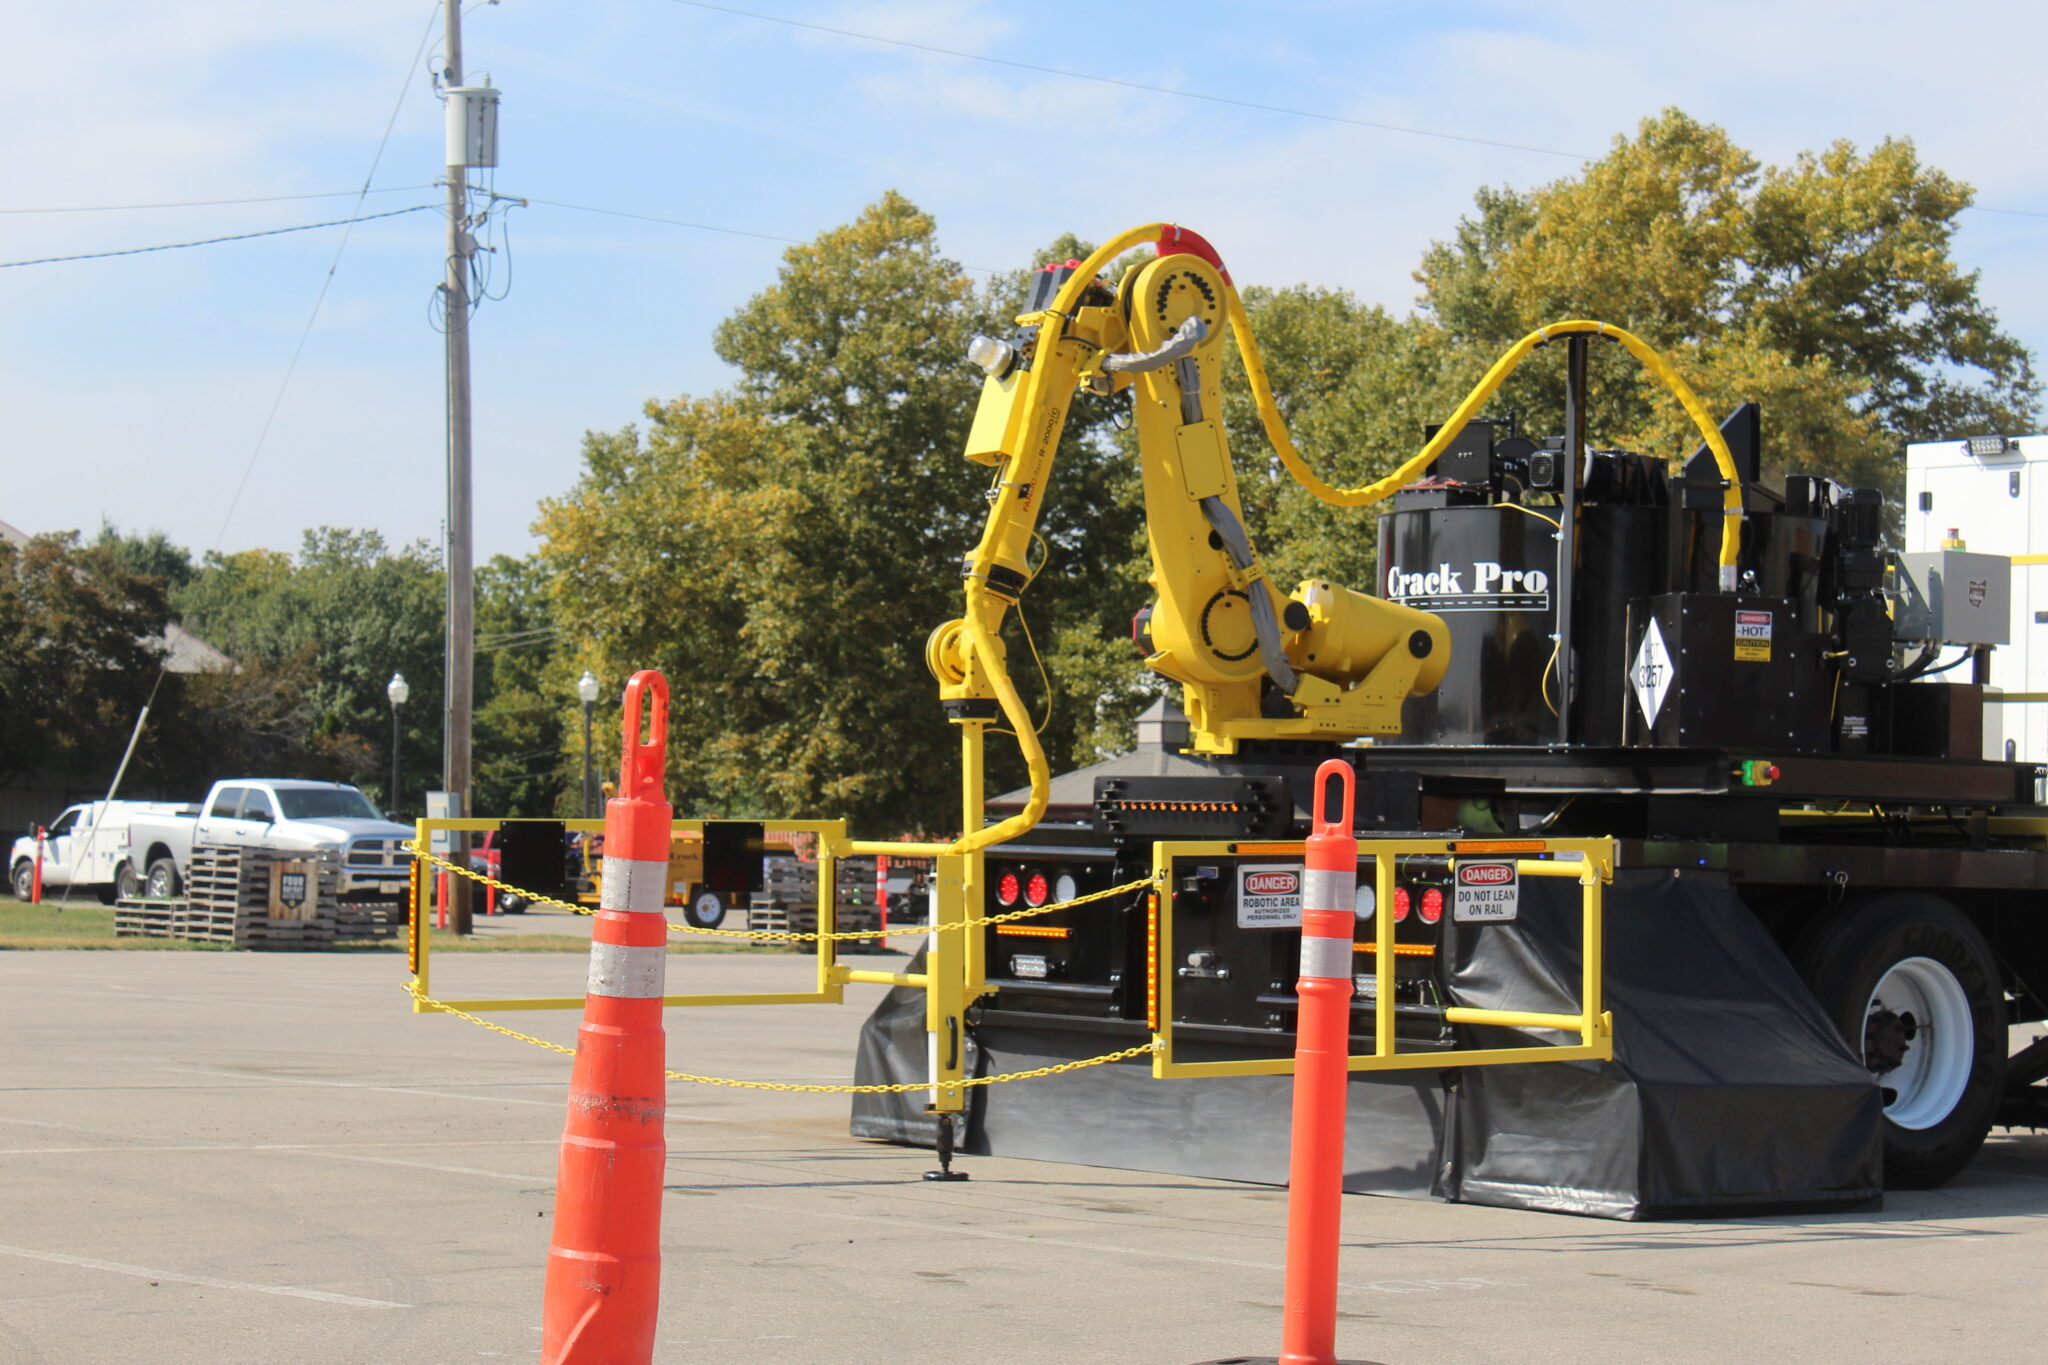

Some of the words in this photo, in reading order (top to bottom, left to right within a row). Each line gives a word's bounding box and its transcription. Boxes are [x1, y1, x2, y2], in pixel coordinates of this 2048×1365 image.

[1387, 562, 1463, 598] Crack
[1473, 562, 1549, 594] Pro
[1741, 614, 1766, 623] DANGER
[1737, 639, 1769, 648] CAUTION
[1645, 643, 1660, 660] HOT
[1639, 665, 1663, 688] 3257
[1465, 868, 1508, 881] DANGER
[1248, 876, 1295, 890] DANGER
[1458, 891, 1471, 902] DO
[1474, 890, 1491, 901] NOT
[1493, 889, 1515, 901] LEAN
[1243, 897, 1279, 908] ROBOTIC
[1280, 897, 1300, 906] AREA
[1469, 904, 1482, 915] ON
[1485, 904, 1504, 915] RAIL
